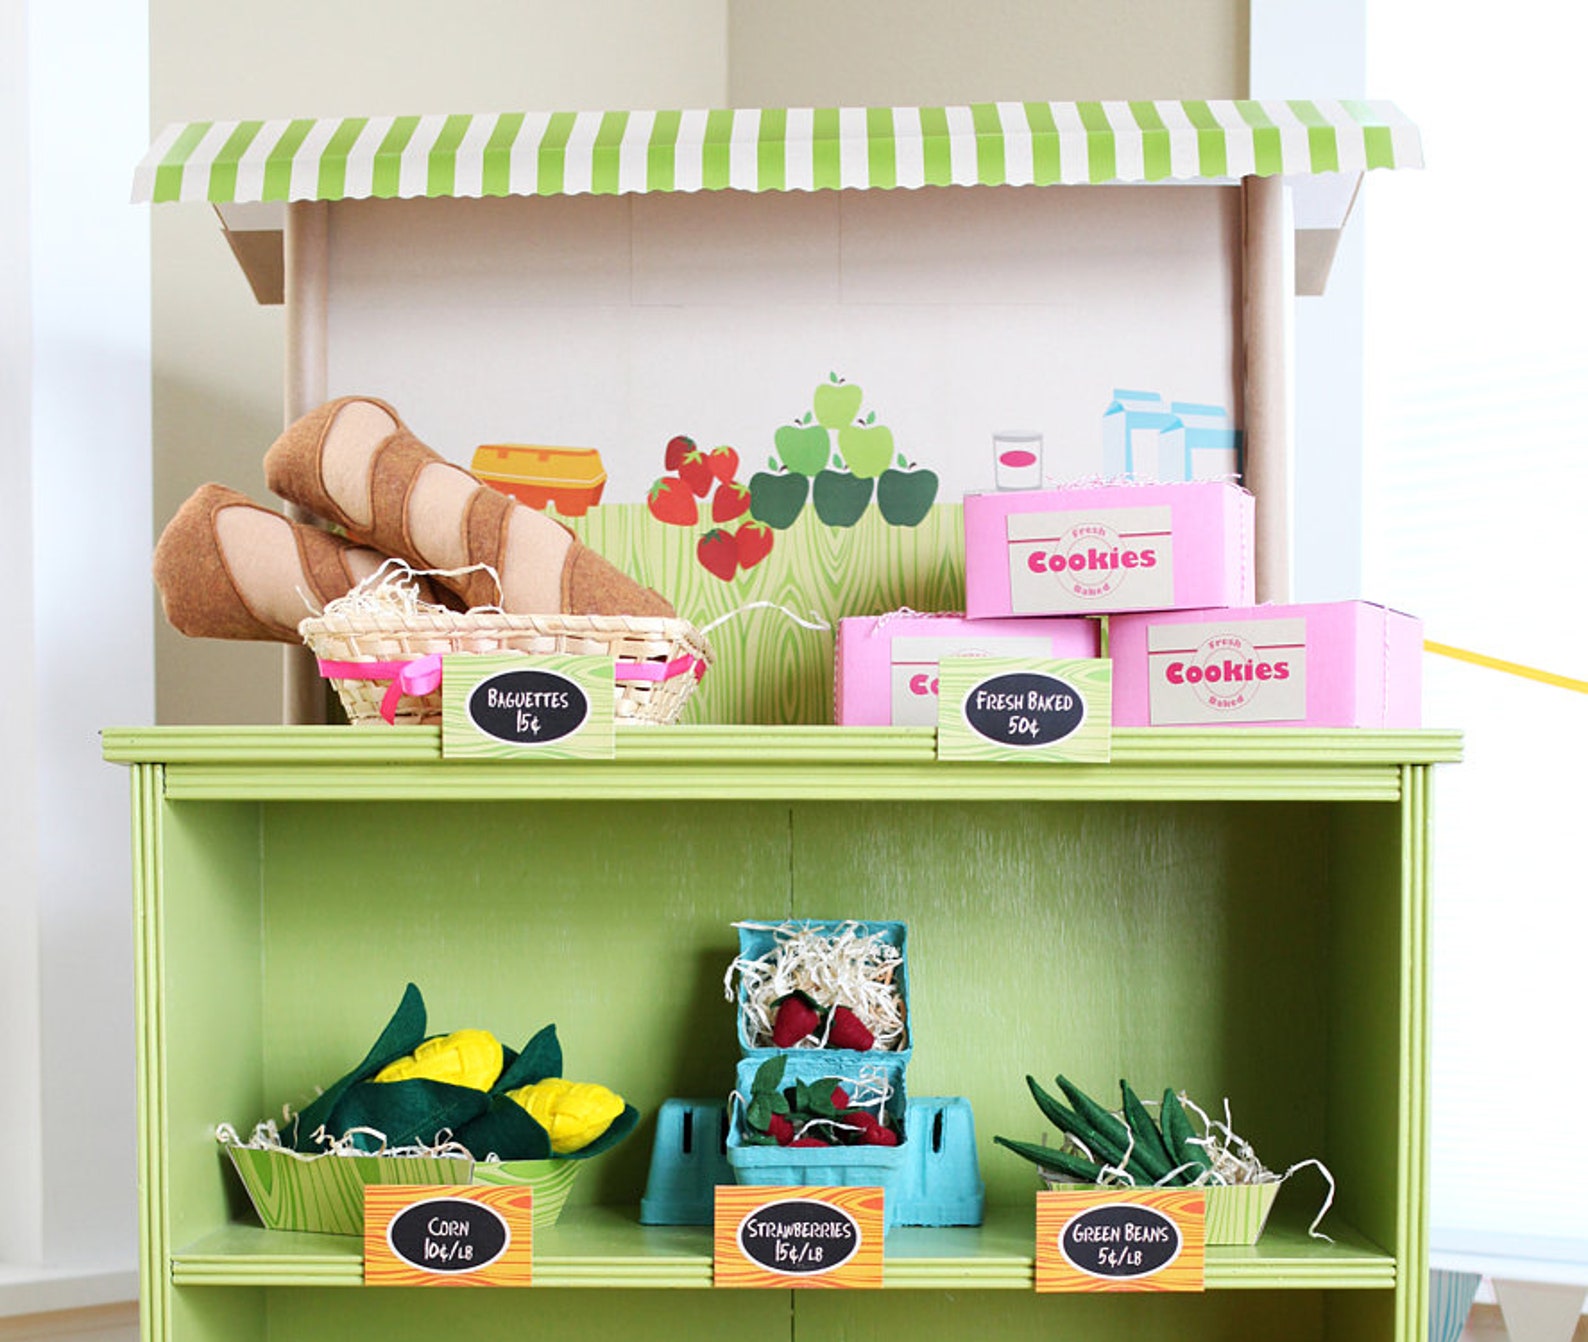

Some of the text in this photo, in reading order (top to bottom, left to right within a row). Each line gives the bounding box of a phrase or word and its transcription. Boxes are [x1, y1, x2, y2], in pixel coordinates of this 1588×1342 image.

[1027, 547, 1157, 573] Cookies
[1166, 659, 1290, 684] Cookies
[487, 687, 569, 709] BAGUETTES
[976, 690, 1073, 712] FRESH BAKED
[516, 709, 541, 735] 15¢
[1008, 715, 1040, 738] 50¢
[428, 1216, 470, 1236] CORN
[747, 1218, 851, 1239] STRAWBERRIES
[1072, 1222, 1170, 1243] GREEN BEANS
[423, 1237, 473, 1262] 10¢/LB
[775, 1239, 823, 1264] 15¢/LB
[1097, 1246, 1143, 1268] 5¢/LB
